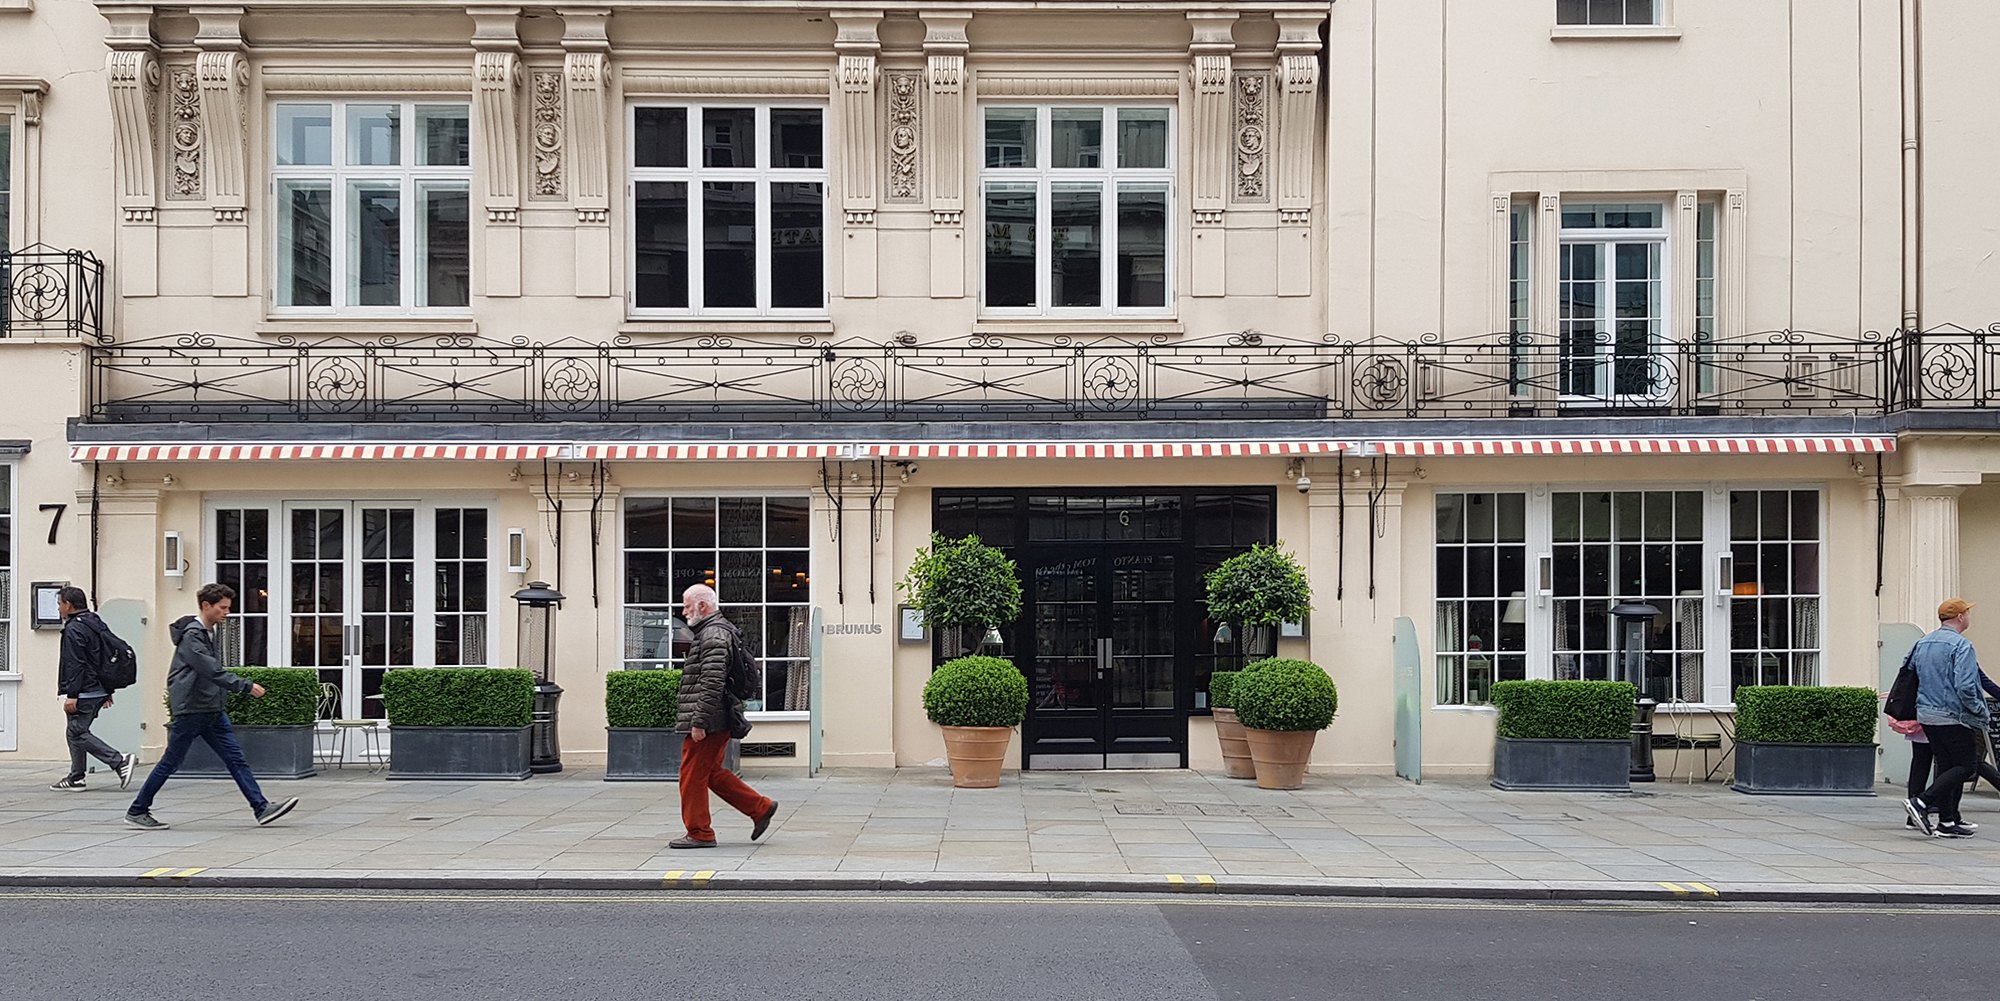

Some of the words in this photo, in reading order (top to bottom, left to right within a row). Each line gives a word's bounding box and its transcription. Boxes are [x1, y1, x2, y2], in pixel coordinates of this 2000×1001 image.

[39, 504, 67, 544] 7
[1119, 510, 1129, 526] 6
[827, 624, 882, 634] BRUMUS
